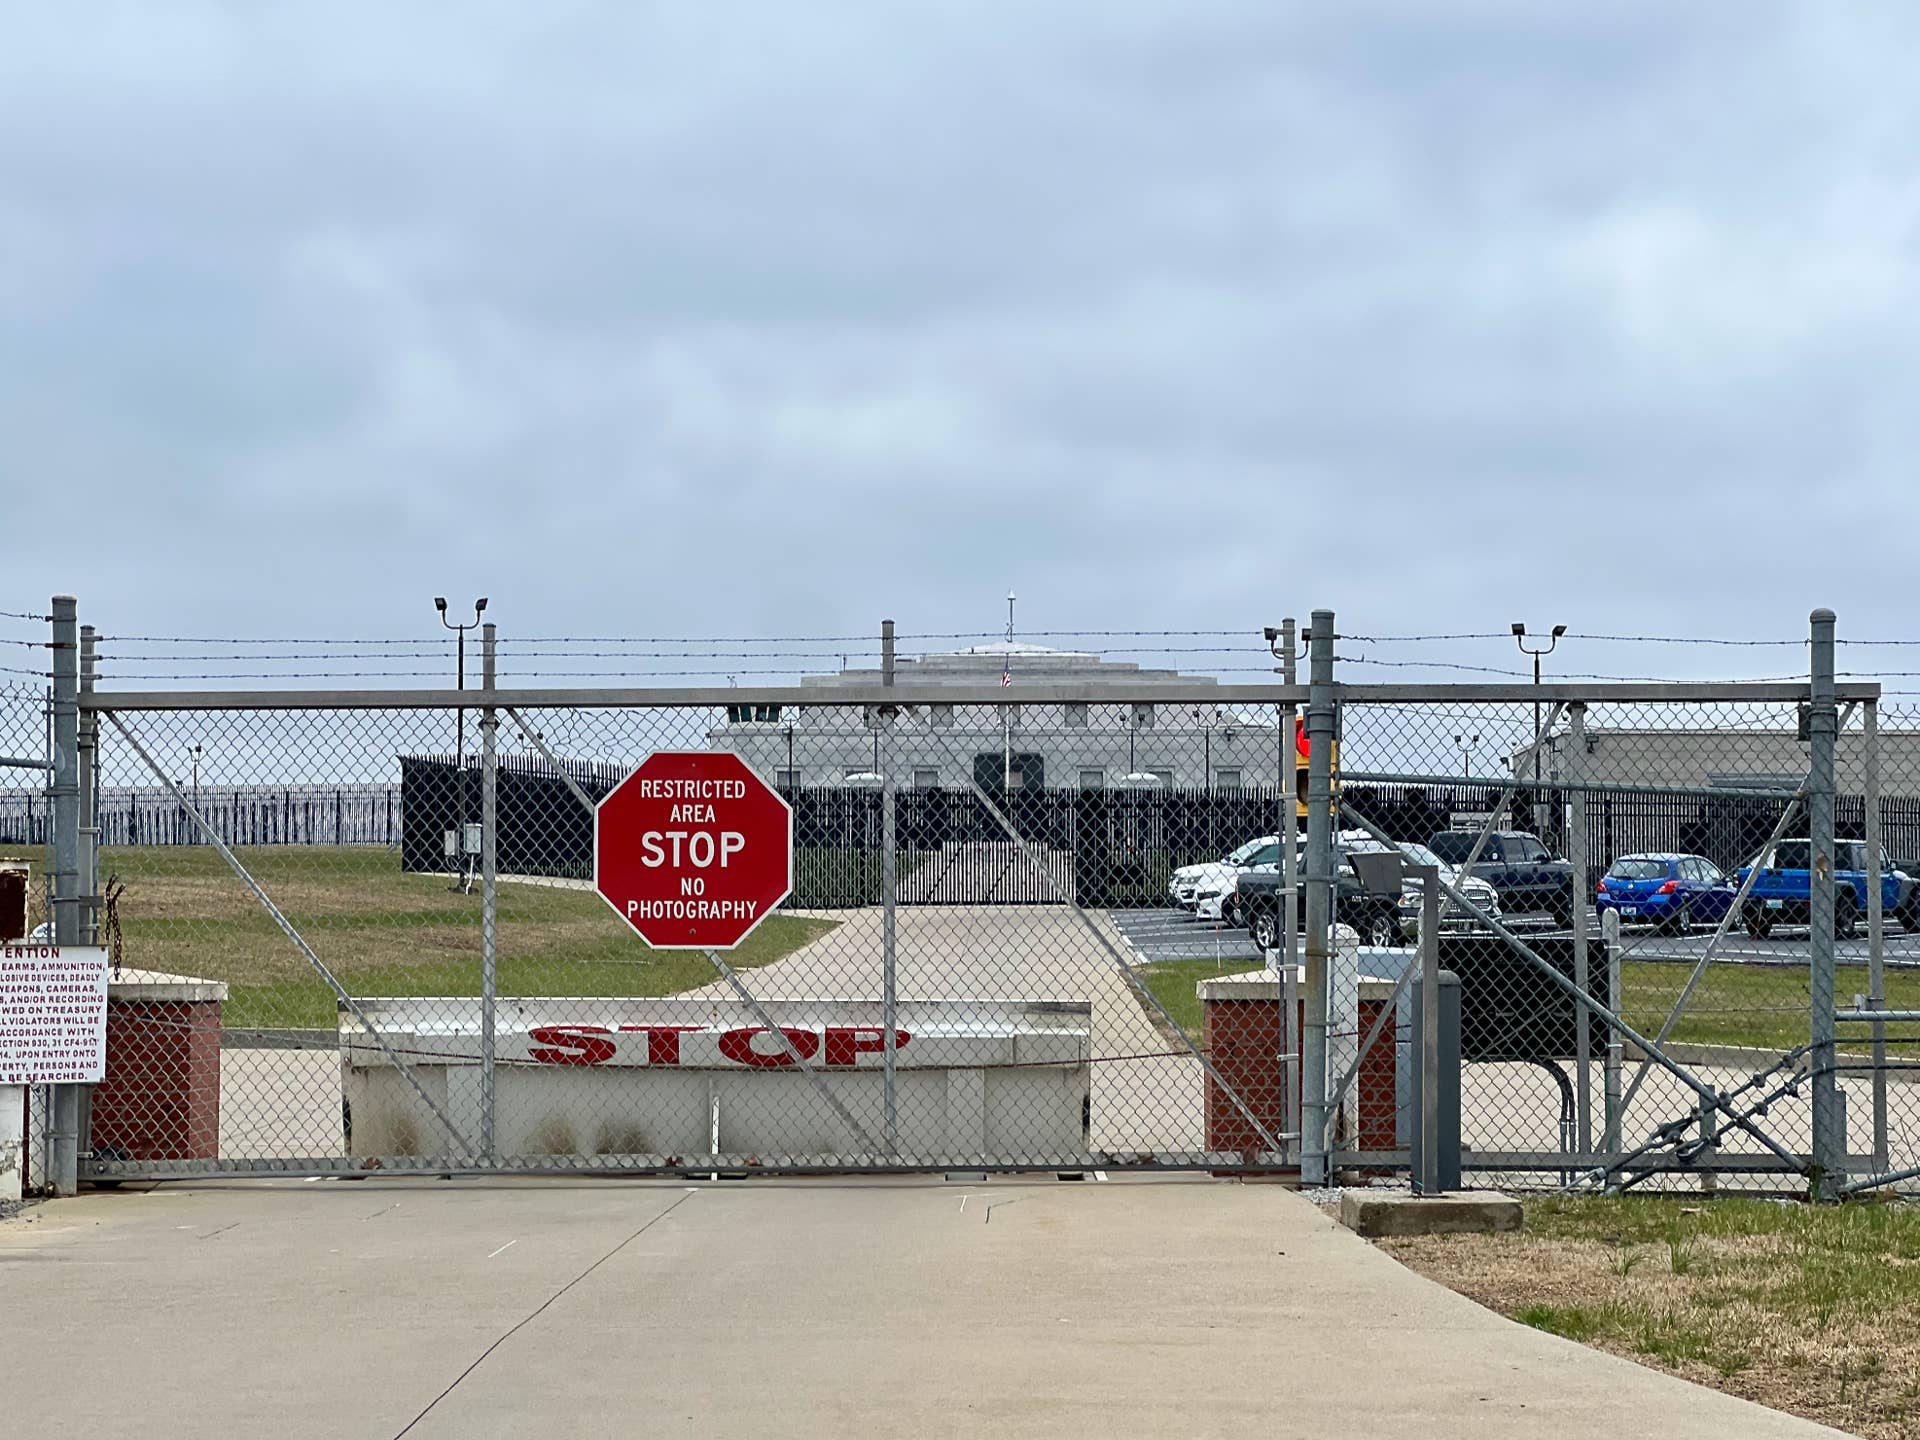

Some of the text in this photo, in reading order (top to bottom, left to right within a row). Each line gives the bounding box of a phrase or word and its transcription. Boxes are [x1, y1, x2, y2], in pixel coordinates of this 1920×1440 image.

[641, 779, 746, 799] RESTRICTED
[669, 804, 716, 823] AREA
[640, 831, 746, 868] STOP
[680, 877, 705, 896] NO
[627, 900, 758, 919] PHOTOGRAPHY
[1, 962, 105, 971] EARMS, AMMUNITION,
[0, 973, 100, 982] LOSIVE DEVICES, DEADLY
[46, 984, 97, 993] CAMERAS,
[48, 995, 104, 1003] RECORDING
[0, 1005, 102, 1014] WED ON TREASURY
[0, 1016, 99, 1025] L VIOLATORS WILL BE
[0, 1028, 95, 1037] ACCORDANCE WITH
[31, 1039, 50, 1048] 930,
[52, 1039, 61, 1047] 31
[528, 1025, 911, 1066] STOP
[16, 1050, 39, 1058] UPON
[42, 1050, 70, 1058] ENTRY
[73, 1049, 97, 1057] ONTO
[0, 1061, 98, 1071] ERTY, PERSONS AND
[8, 1073, 22, 1081] BE
[25, 1072, 88, 1081] SEARCHED.
